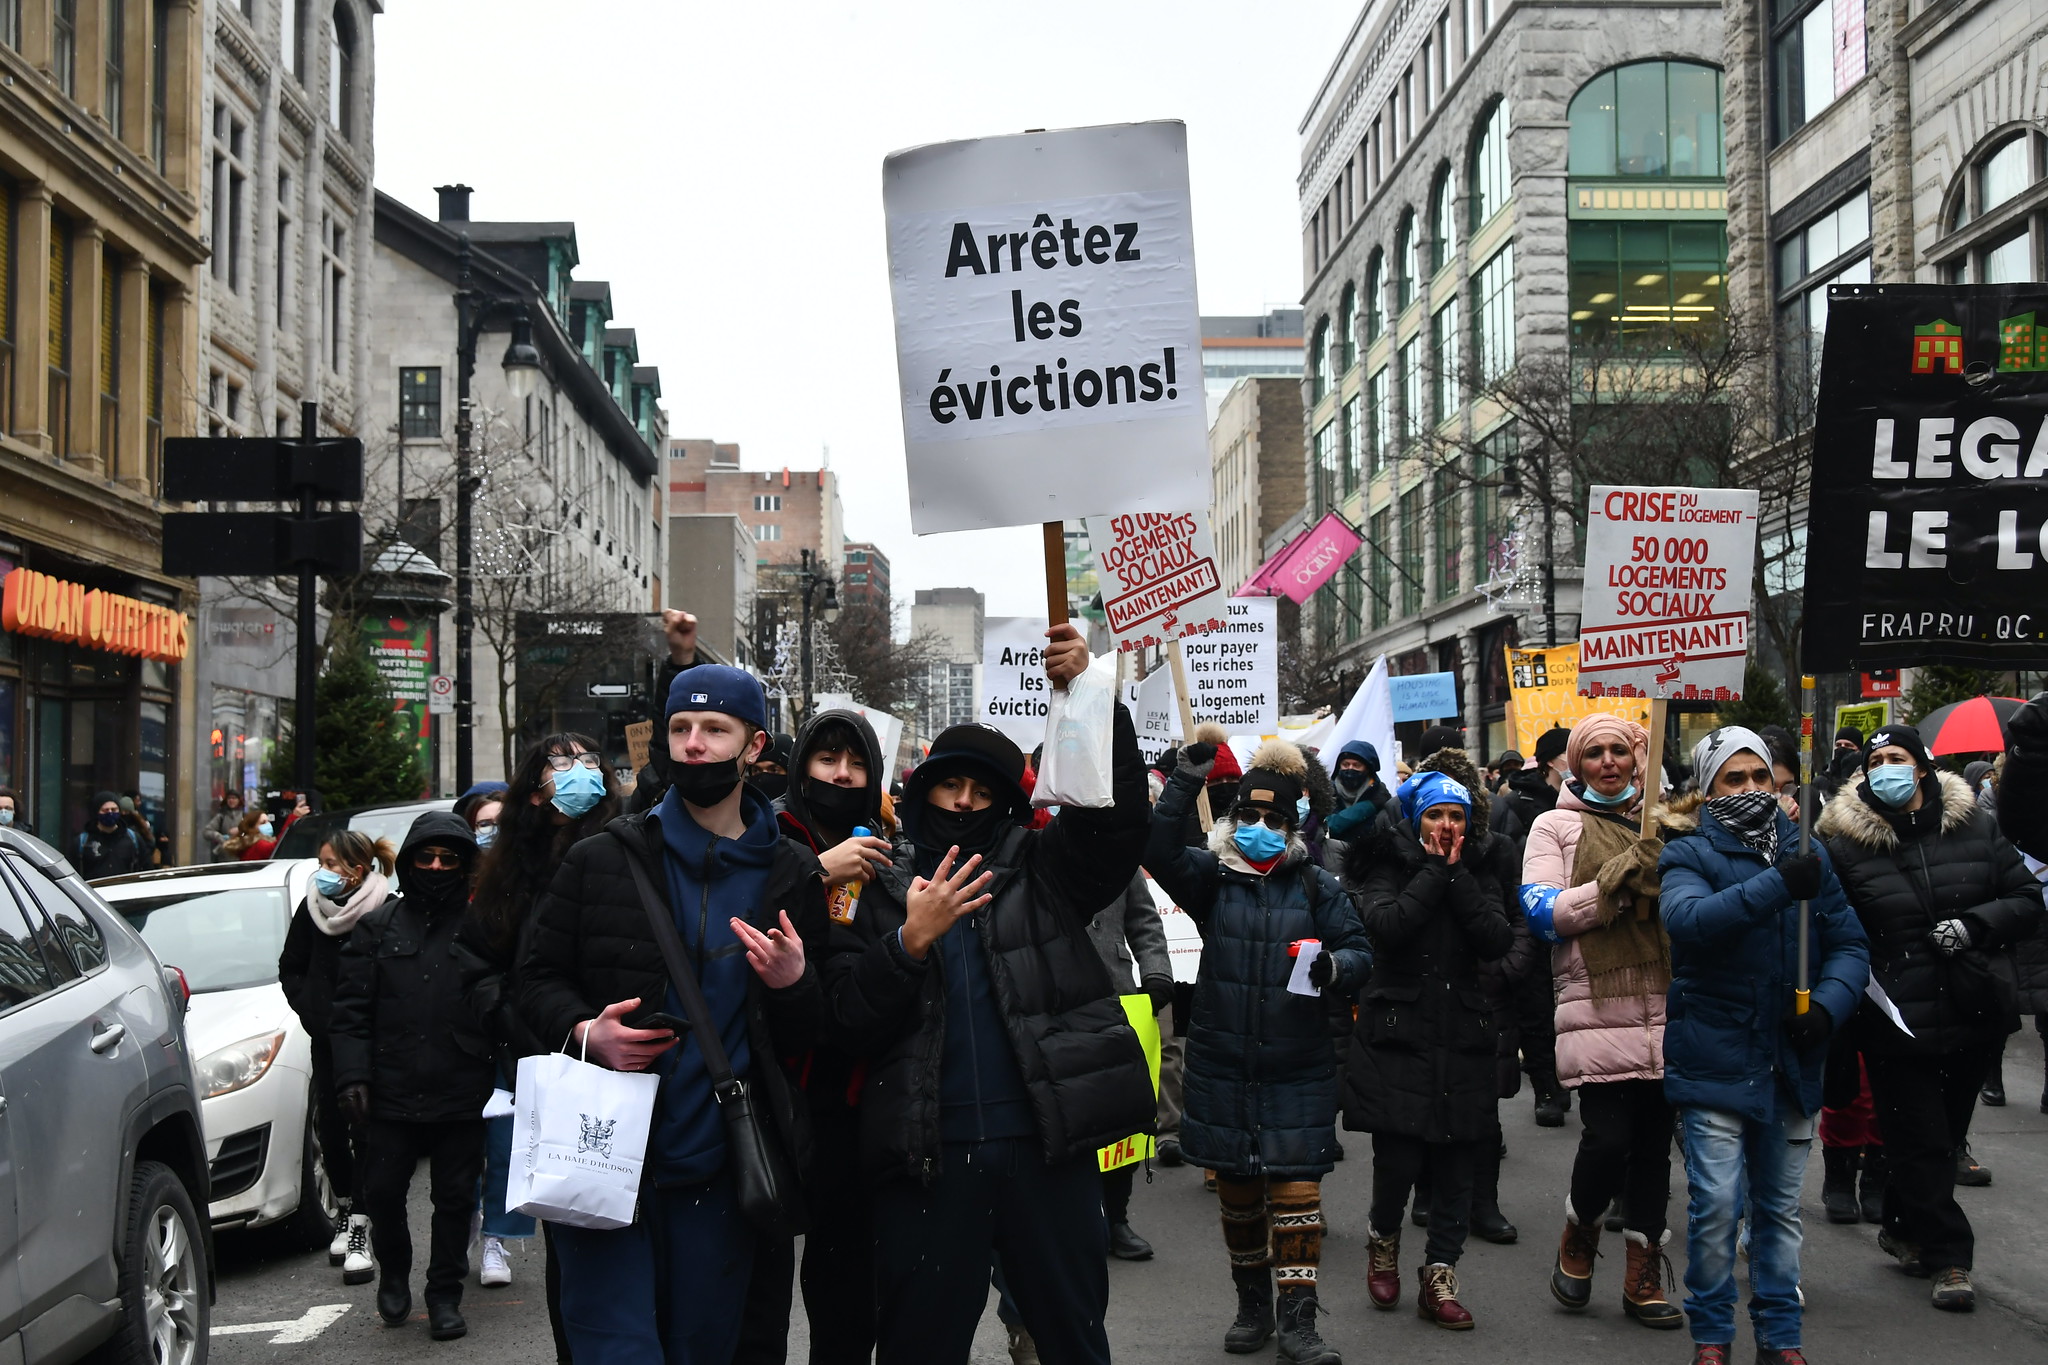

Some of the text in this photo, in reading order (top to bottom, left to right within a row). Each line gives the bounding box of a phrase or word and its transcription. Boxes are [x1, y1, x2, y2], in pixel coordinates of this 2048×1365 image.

[945, 213, 1141, 278] Arrêtez
[1011, 289, 1082, 342] les
[929, 347, 1178, 424] évictions!
[1604, 491, 1676, 522] CRISE
[1680, 493, 1697, 507] DU
[1679, 509, 1742, 524] LOGEMENT
[1110, 514, 1135, 543] 50
[1865, 510, 2048, 570] LE L
[1101, 513, 1197, 573] LOGEMENTS
[1631, 536, 1708, 565] 50 000
[1117, 537, 1199, 592] SOCIAUX
[1296, 541, 1340, 585] OGILVY
[1608, 565, 1727, 590] LOGEMENTS
[10, 567, 190, 662] URBAN OUTFITTERS
[1617, 590, 1715, 617] SOCIAUX
[1000, 646, 1045, 667] Arrêt
[1186, 642, 1259, 658] pour payer
[1191, 657, 1254, 672] les riches
[1549, 662, 1579, 674] COM
[1020, 672, 1044, 691] les
[1198, 678, 1247, 690] au nom
[1551, 678, 1563, 687] DU
[988, 696, 1049, 717] évictio
[1201, 693, 1266, 711] logement
[1146, 720, 1161, 731] DE
[1872, 740, 1890, 750] adidas
[548, 1153, 562, 1161] LA
[564, 1154, 588, 1165] BAIE
[590, 1160, 634, 1176] D'HUDSON
